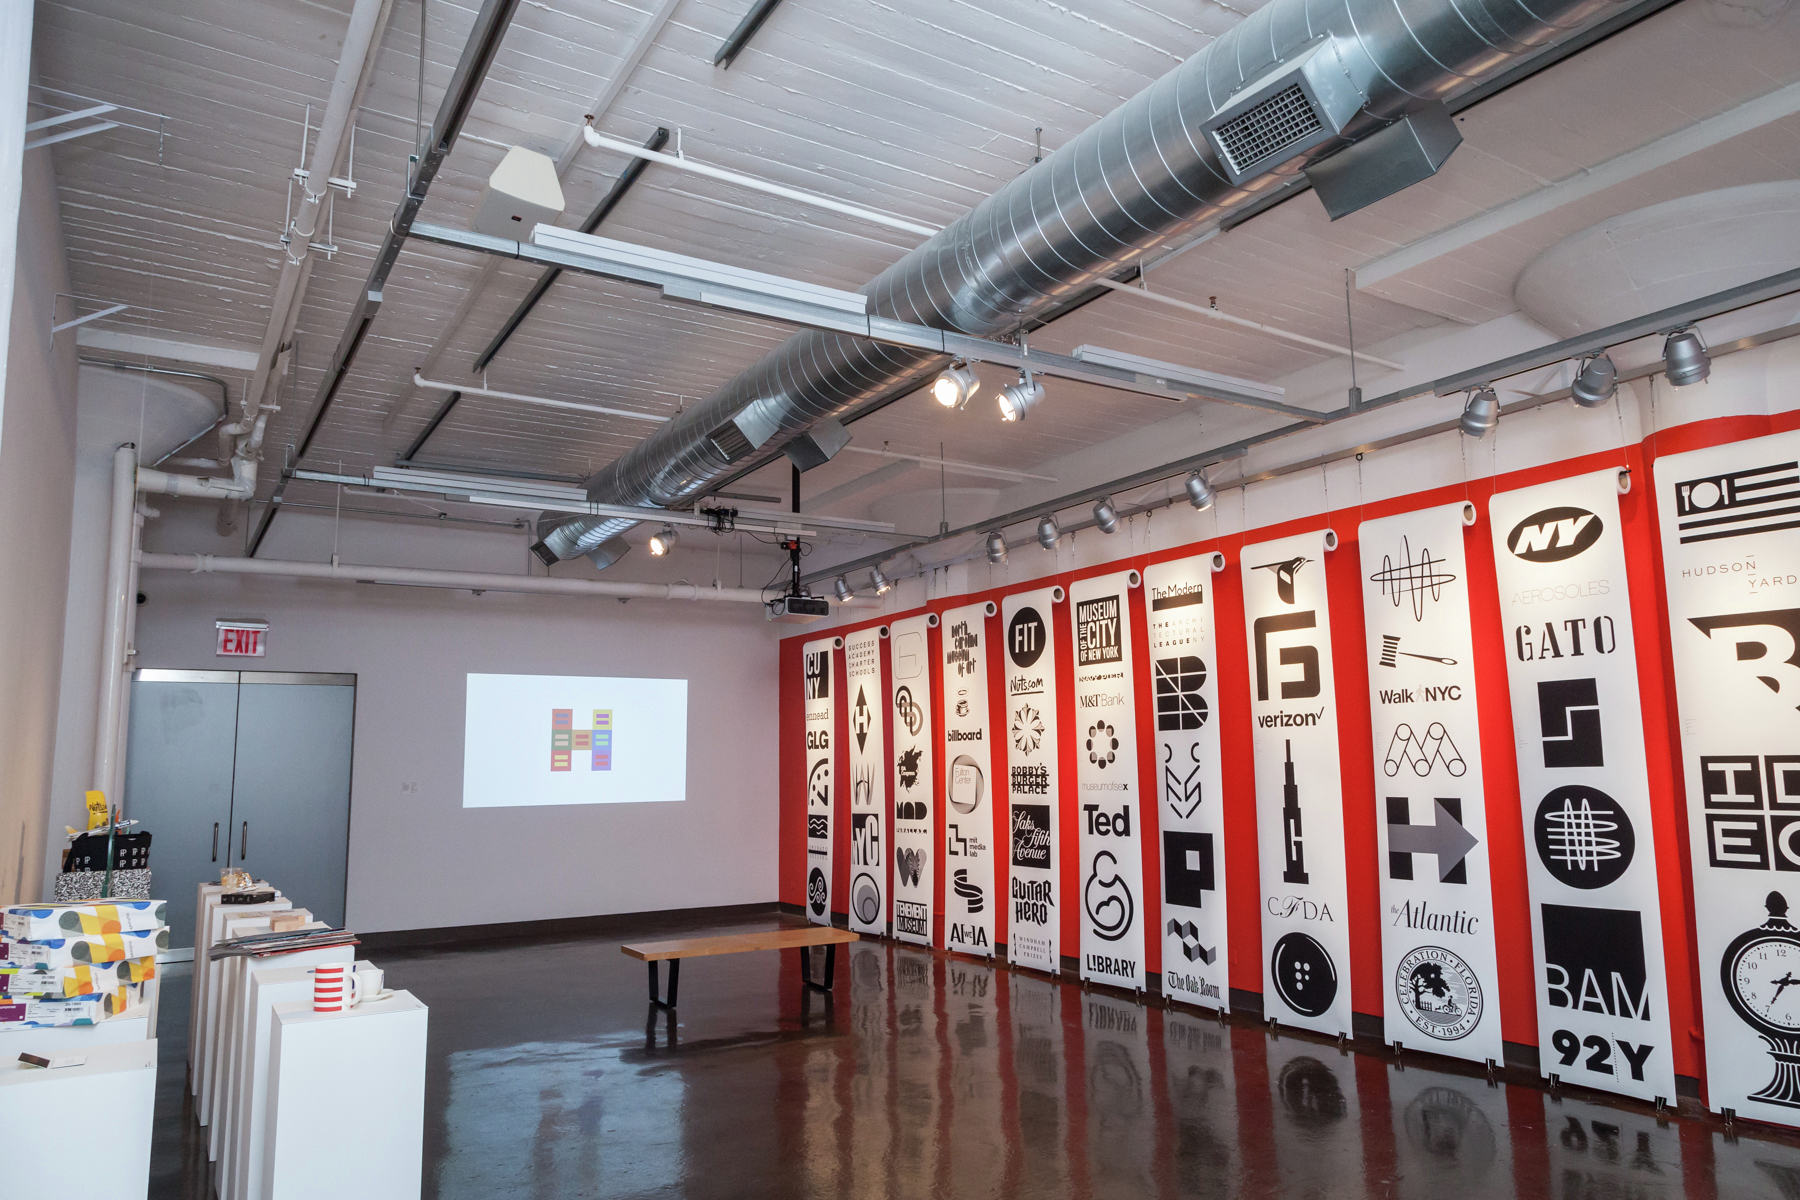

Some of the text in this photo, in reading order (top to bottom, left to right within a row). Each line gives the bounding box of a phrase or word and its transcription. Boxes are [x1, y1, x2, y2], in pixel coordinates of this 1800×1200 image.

[1513, 513, 1597, 555] NY
[1682, 561, 1756, 578] HUDSON
[1152, 582, 1203, 600] The Modern
[1512, 580, 1610, 607] AEROSOLES
[1079, 600, 1117, 622] MUSEUM
[1153, 616, 1203, 630] THE ARCHI
[1014, 621, 1038, 654] FIT
[1079, 623, 1087, 650] OF THE
[1087, 619, 1117, 650] CITY
[1153, 627, 1205, 638] TECTURAL
[1515, 615, 1616, 662] GATO
[222, 629, 260, 654] EXIT
[848, 640, 874, 652] SUCCESS
[1154, 638, 1190, 648] LEAGUE
[848, 649, 874, 660] ACADEMY
[849, 658, 874, 668] CHARTER
[1080, 646, 1119, 663] OF NEW YORK
[807, 652, 821, 676] CU
[958, 662, 964, 678] of
[849, 668, 876, 678] SCHOOLS
[807, 677, 821, 700] NY
[1010, 675, 1044, 693] Nuts.com
[1080, 692, 1125, 708] M&T Bank
[1380, 685, 1462, 705] Walk NYC
[807, 708, 829, 721] ennead
[1258, 711, 1317, 728] verizon
[807, 730, 829, 750] GLG
[948, 728, 982, 742] billboard
[955, 767, 970, 777] Fulton
[1012, 762, 1048, 775] BOBBY'S
[955, 776, 972, 785] Center
[1012, 776, 1048, 786] BURGER
[1082, 782, 1128, 791] museumofsex
[1012, 786, 1048, 795] PALACE
[1012, 810, 1035, 834] Saks
[1083, 804, 1131, 837] Ted
[852, 815, 879, 867] NYC
[1012, 836, 1046, 861] Avenue
[896, 903, 927, 919] TENEMENT
[1267, 896, 1335, 922] CFDA
[1391, 898, 1479, 935] the Atlantic
[898, 917, 928, 936] MUSEUM
[1019, 936, 1046, 946] WINDHAM
[1019, 943, 1046, 954] CAMPBELL
[1023, 952, 1043, 960] PRIZES
[1760, 952, 1768, 960] 11
[1776, 949, 1786, 957] 12
[1748, 962, 1758, 970] 10
[1168, 971, 1221, 1000] The Oak Room
[1401, 950, 1480, 1017] CELEBRATION FLORIDA
[1546, 963, 1650, 1021] BAM
[1443, 1024, 1467, 1038] 1994
